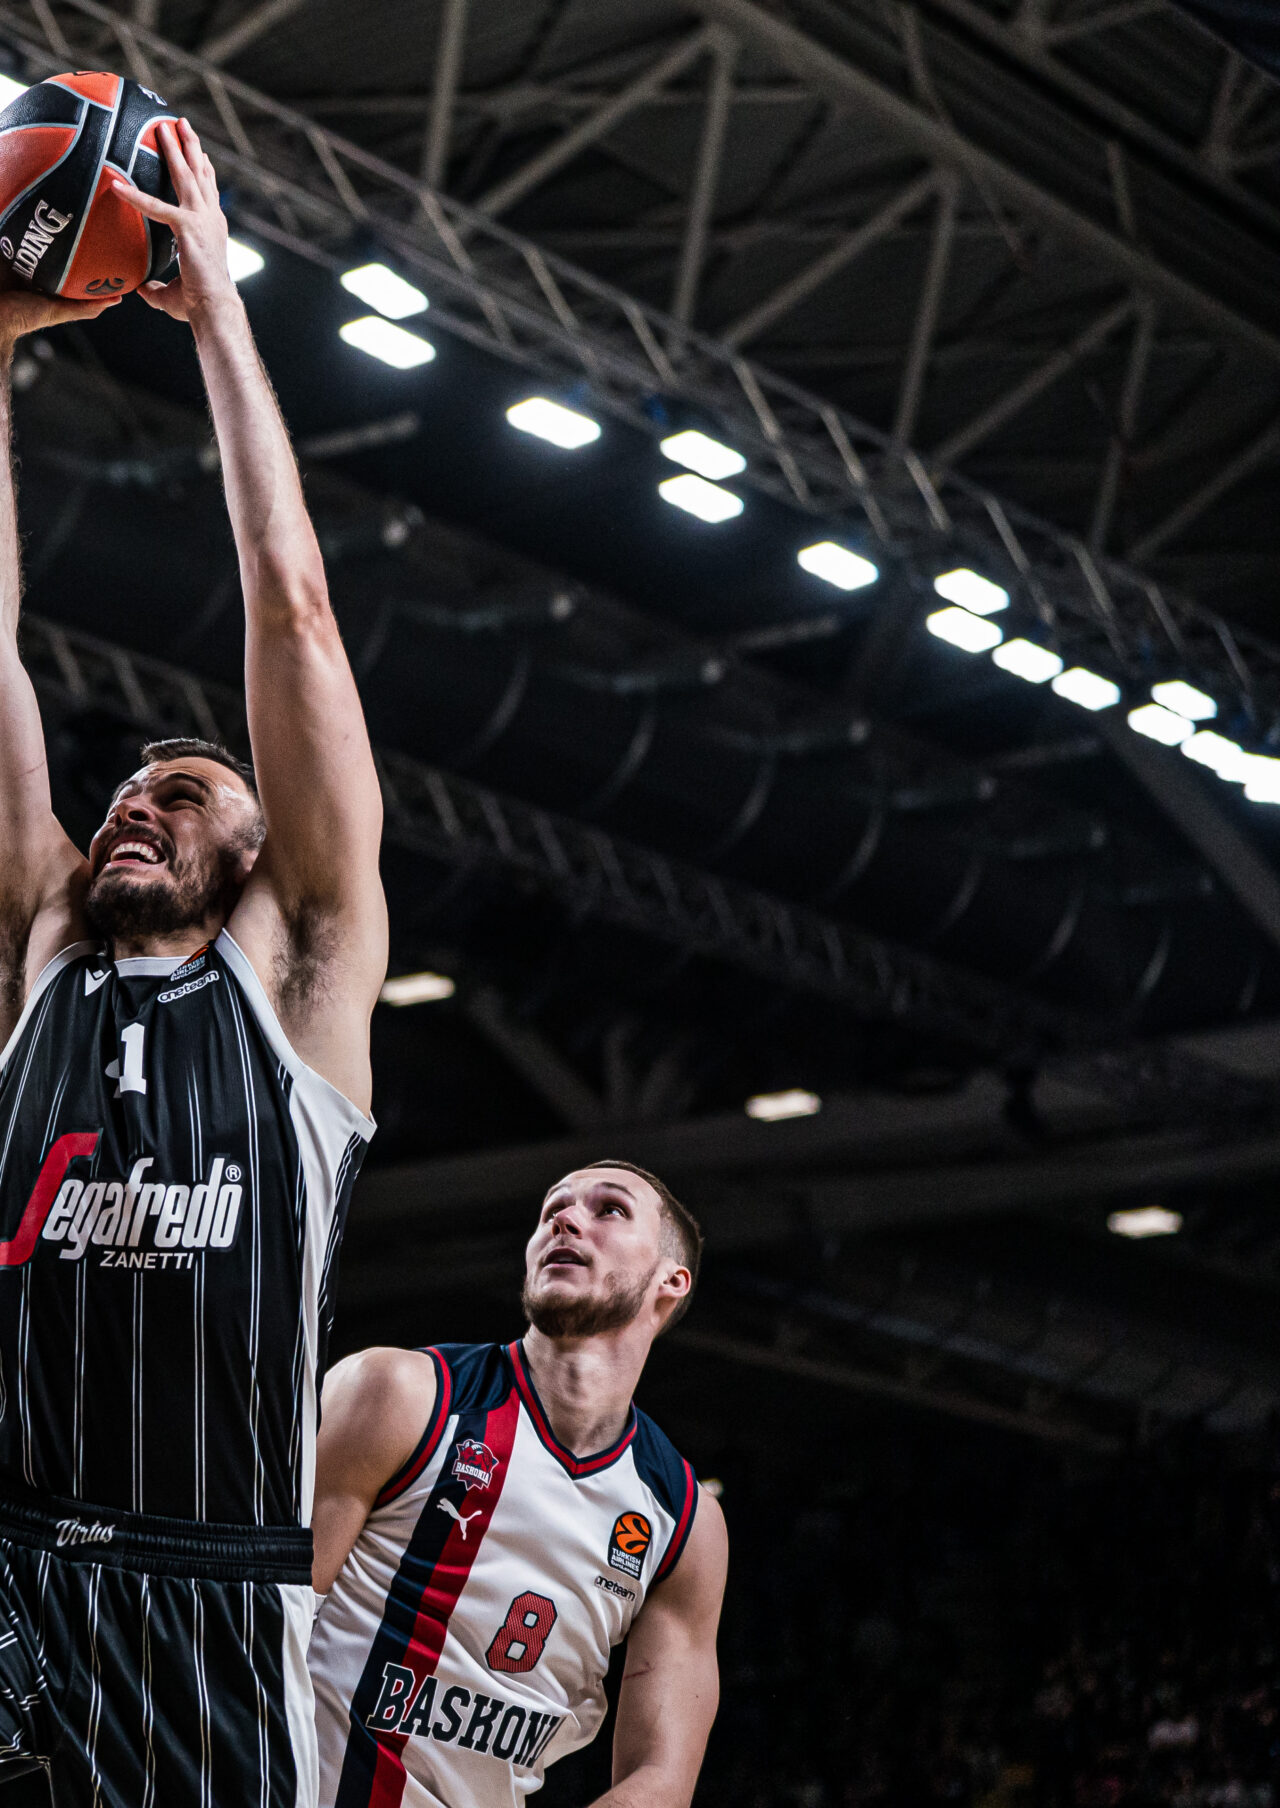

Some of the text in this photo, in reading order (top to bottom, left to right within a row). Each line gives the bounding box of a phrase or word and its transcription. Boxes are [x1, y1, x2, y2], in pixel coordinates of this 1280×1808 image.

[158, 970, 219, 1003] oneteam
[99, 1250, 194, 1270] ZANETTI
[455, 1462, 490, 1484] BASKONIA
[56, 1517, 116, 1547] Virtus
[610, 1555, 640, 1573] AIRLINES
[611, 1547, 641, 1566] TURKISH
[485, 1590, 558, 1673] 8
[366, 1662, 568, 1769] BASKONI
